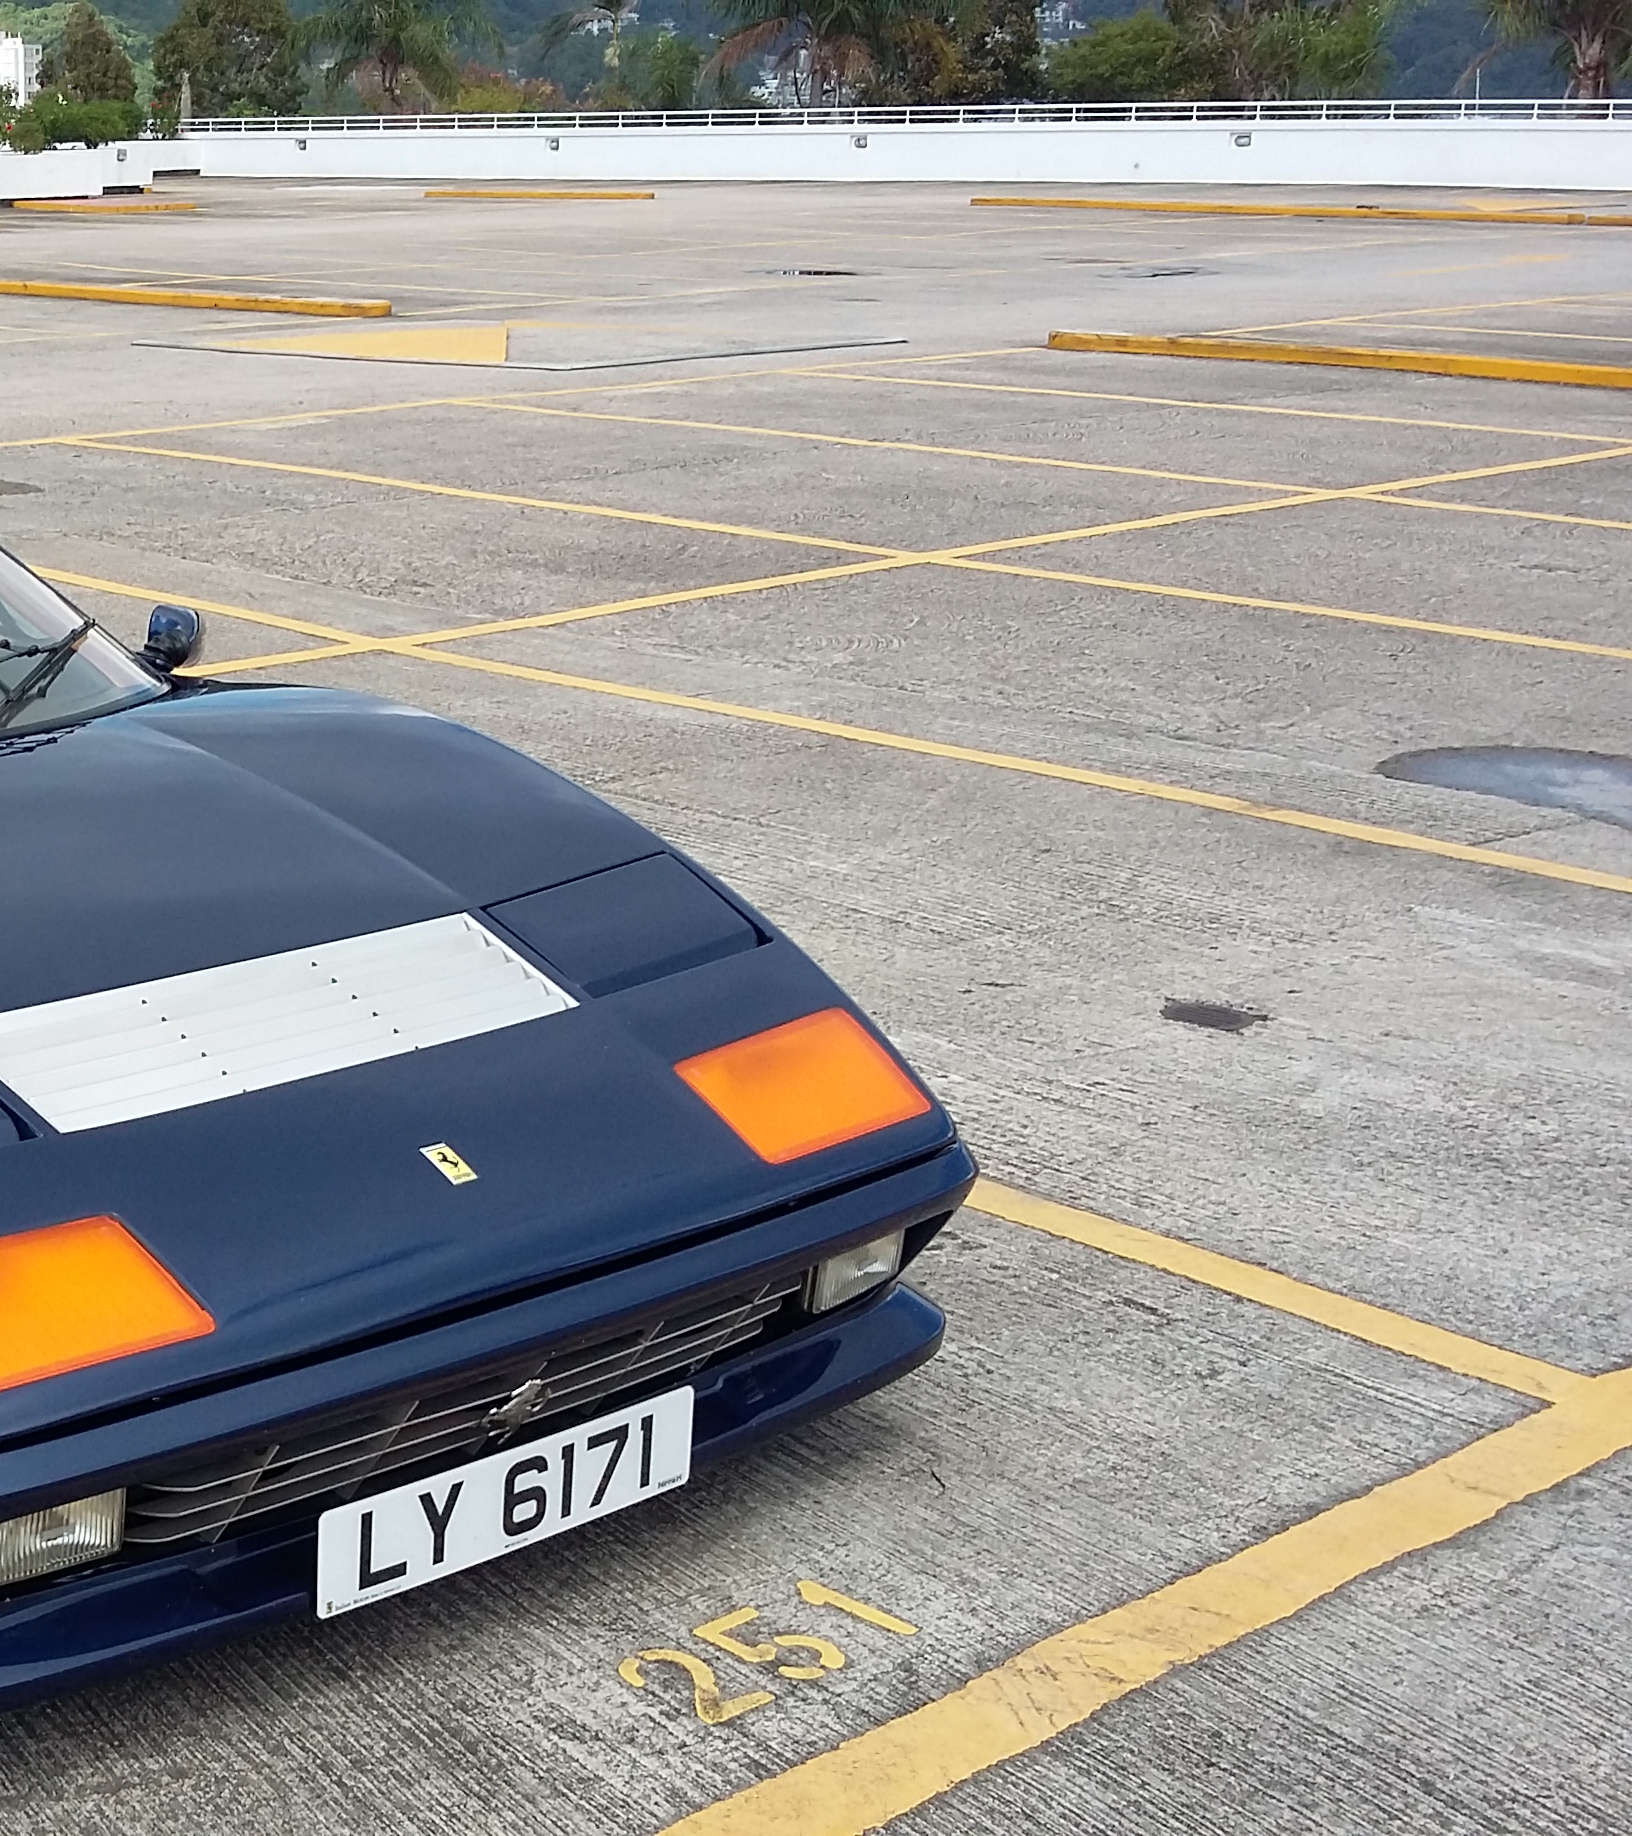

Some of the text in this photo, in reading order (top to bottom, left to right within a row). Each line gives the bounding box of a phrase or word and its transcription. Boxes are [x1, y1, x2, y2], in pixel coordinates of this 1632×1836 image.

[358, 1413, 654, 1591] LY 6171
[618, 1579, 920, 1725] 251
